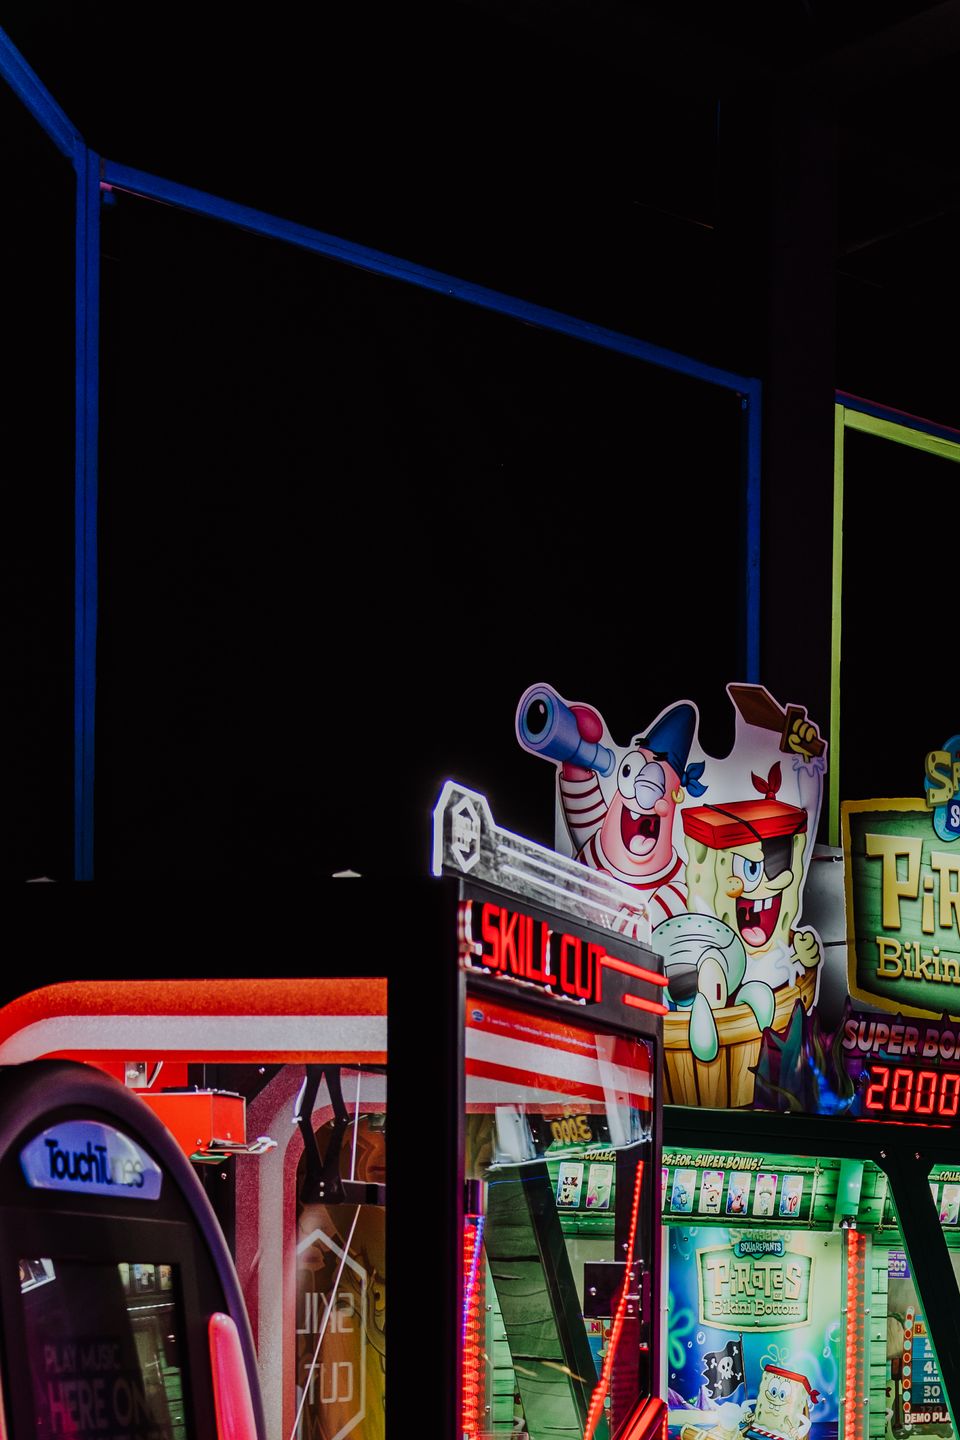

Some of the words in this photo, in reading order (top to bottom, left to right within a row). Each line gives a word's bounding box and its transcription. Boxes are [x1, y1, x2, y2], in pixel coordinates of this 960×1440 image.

[481, 901, 558, 986] SKILL
[841, 1018, 919, 1056] SUPER
[675, 1154, 692, 1168] FOR
[694, 1155, 727, 1169] SUPER
[726, 1156, 764, 1171] BONUS!
[740, 1242, 782, 1253] SQUAREPANTS
[711, 1300, 752, 1316] Bikini
[754, 1299, 801, 1317] Bottom
[44, 1344, 77, 1373] PLAY
[923, 1385, 941, 1397] 30
[48, 1378, 109, 1434] HERE
[113, 1376, 156, 1427] ON
[904, 1412, 931, 1424] DEMO
